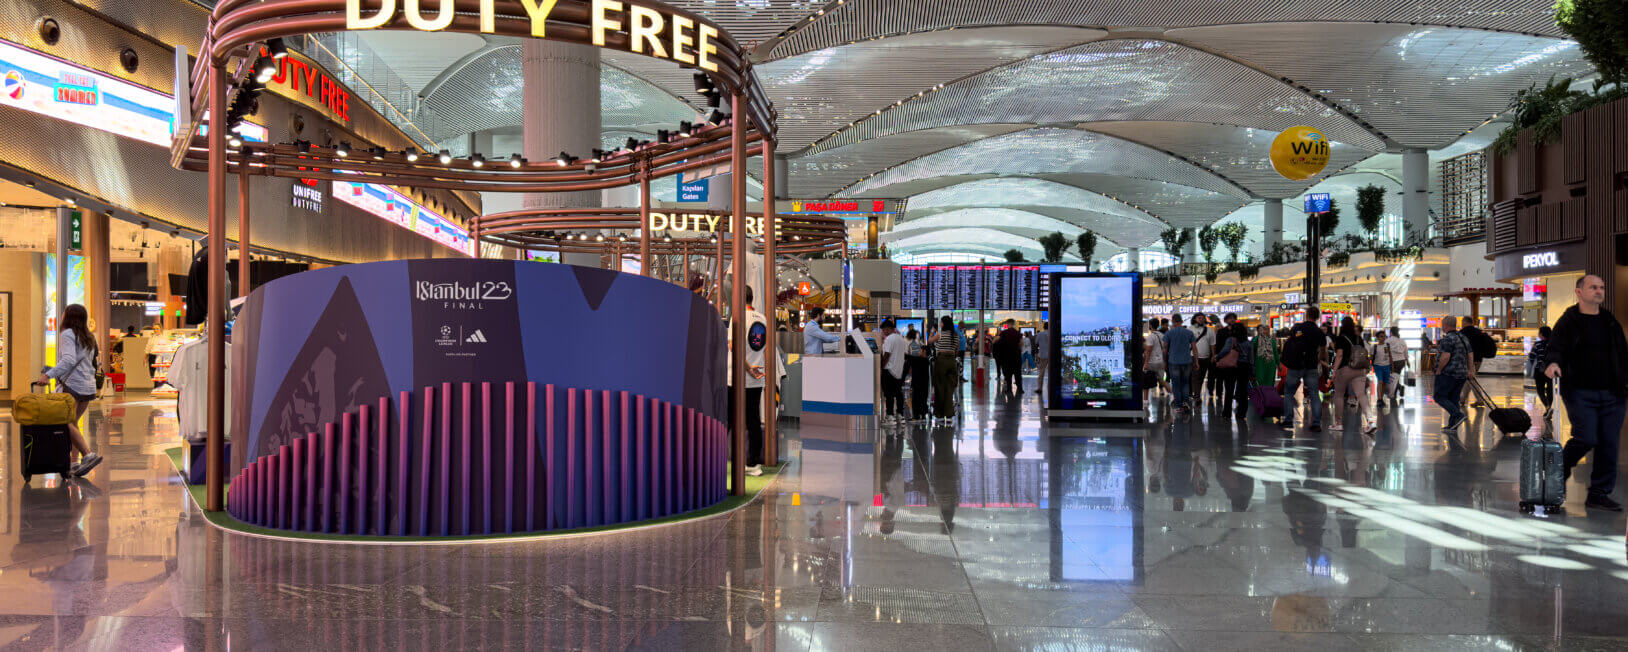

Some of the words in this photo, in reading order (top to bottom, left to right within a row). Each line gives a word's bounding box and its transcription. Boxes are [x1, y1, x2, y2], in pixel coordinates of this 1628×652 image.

[592, 0, 718, 72] FREE
[321, 74, 350, 122] FREE
[293, 183, 322, 203] UNIFREE
[829, 201, 858, 211] DÖNER
[650, 213, 720, 233] DUTY
[1201, 305, 1219, 313] JUICE
[1220, 305, 1244, 313] BAKERY
